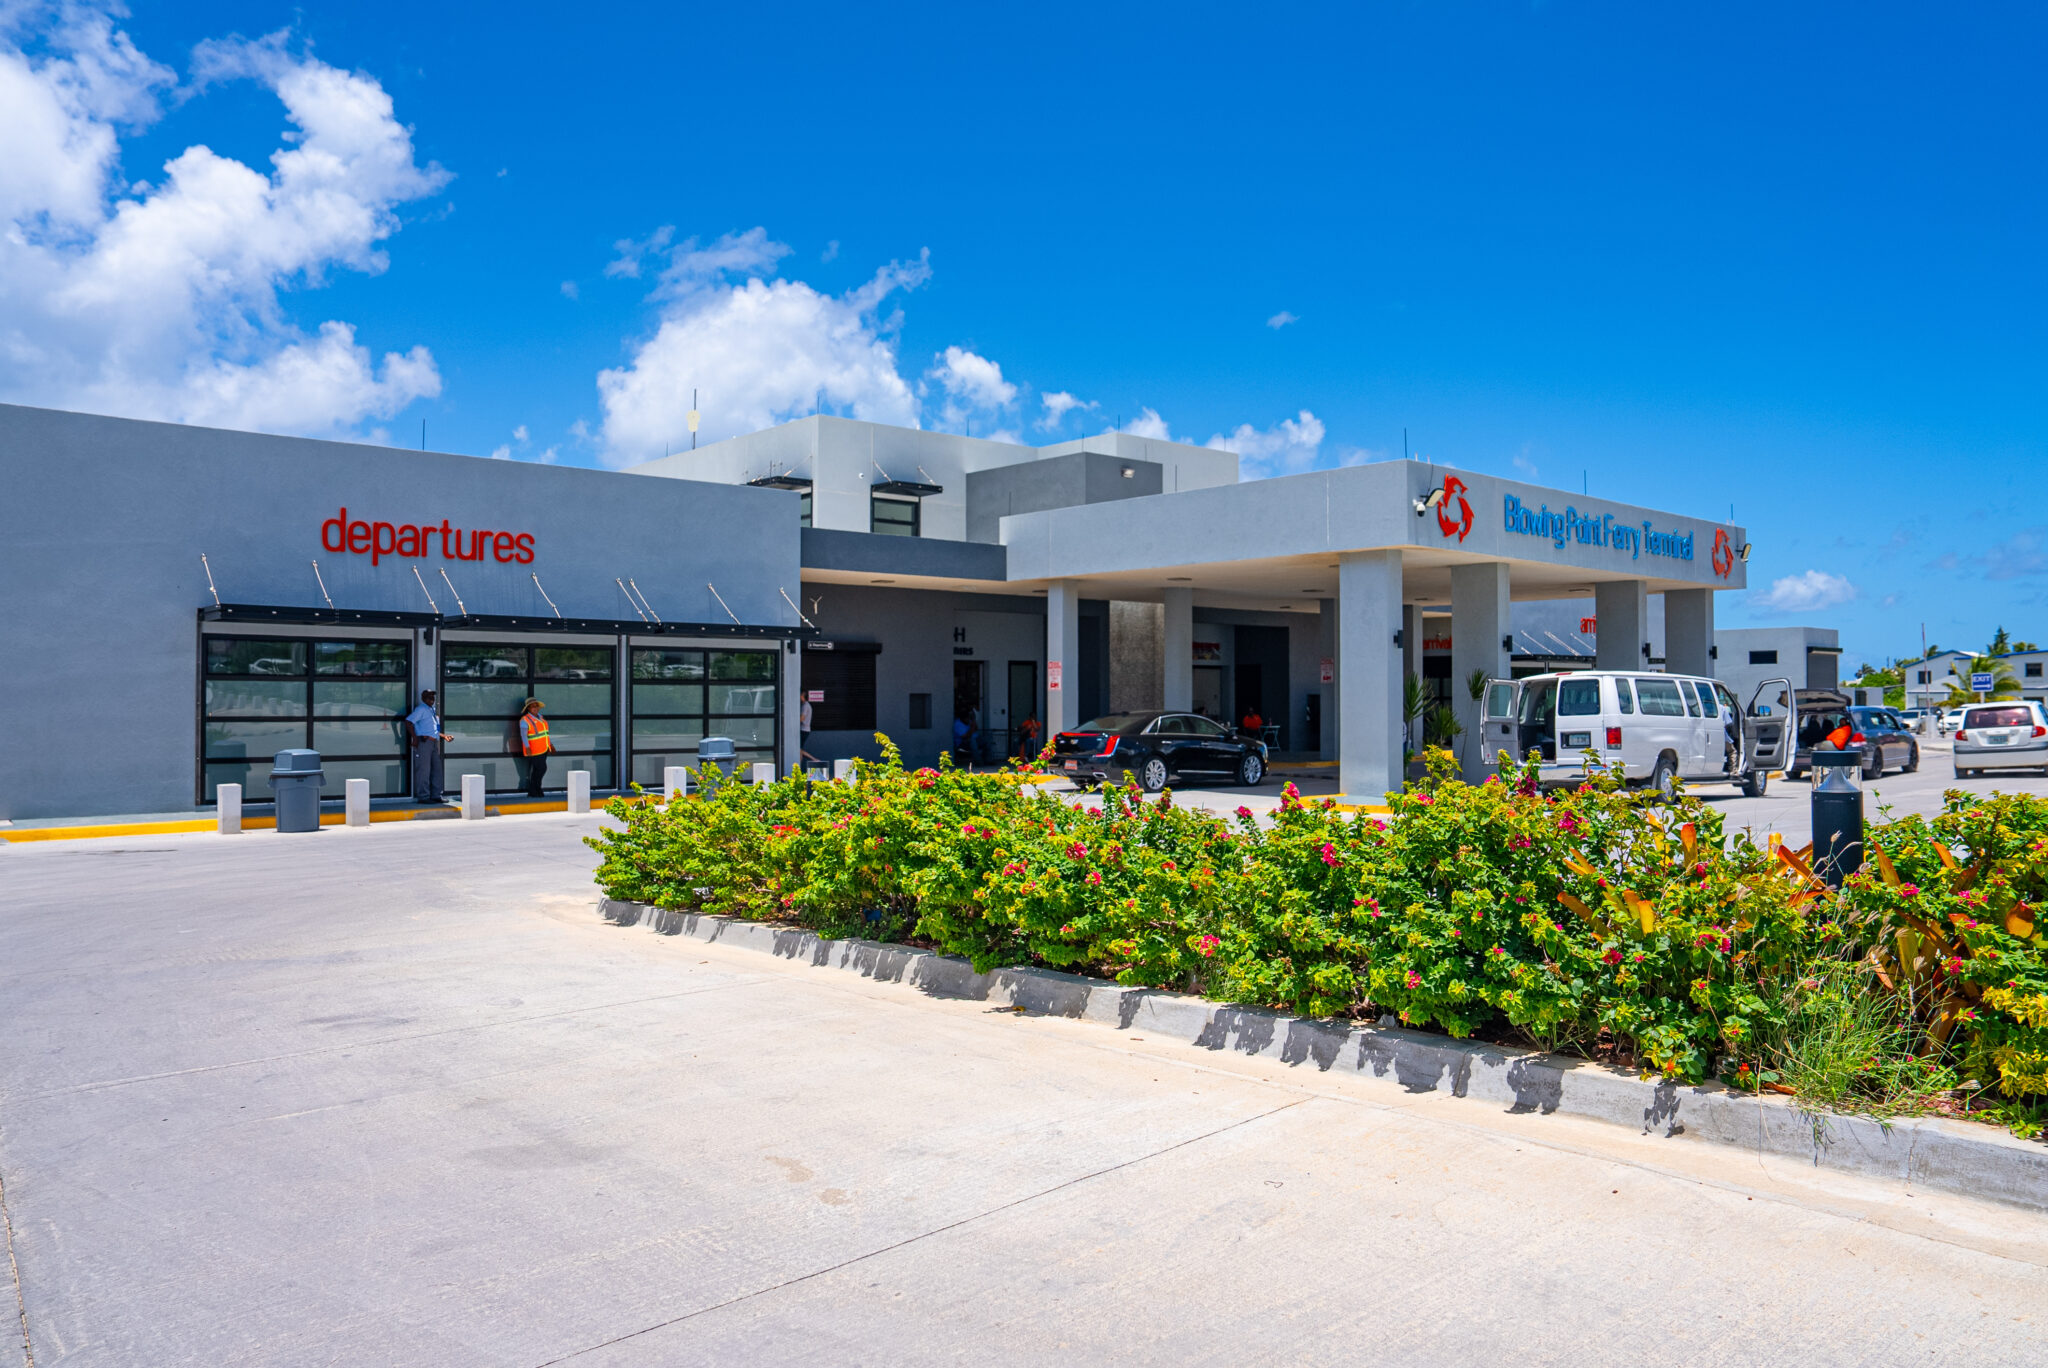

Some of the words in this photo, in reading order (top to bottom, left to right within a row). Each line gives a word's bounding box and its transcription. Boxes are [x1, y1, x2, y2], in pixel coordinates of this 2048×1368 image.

[321, 506, 535, 567] departures
[1504, 494, 1565, 549] Blowing
[1566, 506, 1603, 547] Point
[1603, 513, 1641, 560] Ferry
[1642, 520, 1694, 561] Terminal
[1423, 635, 1452, 650] arrival
[1580, 614, 1596, 634] arri
